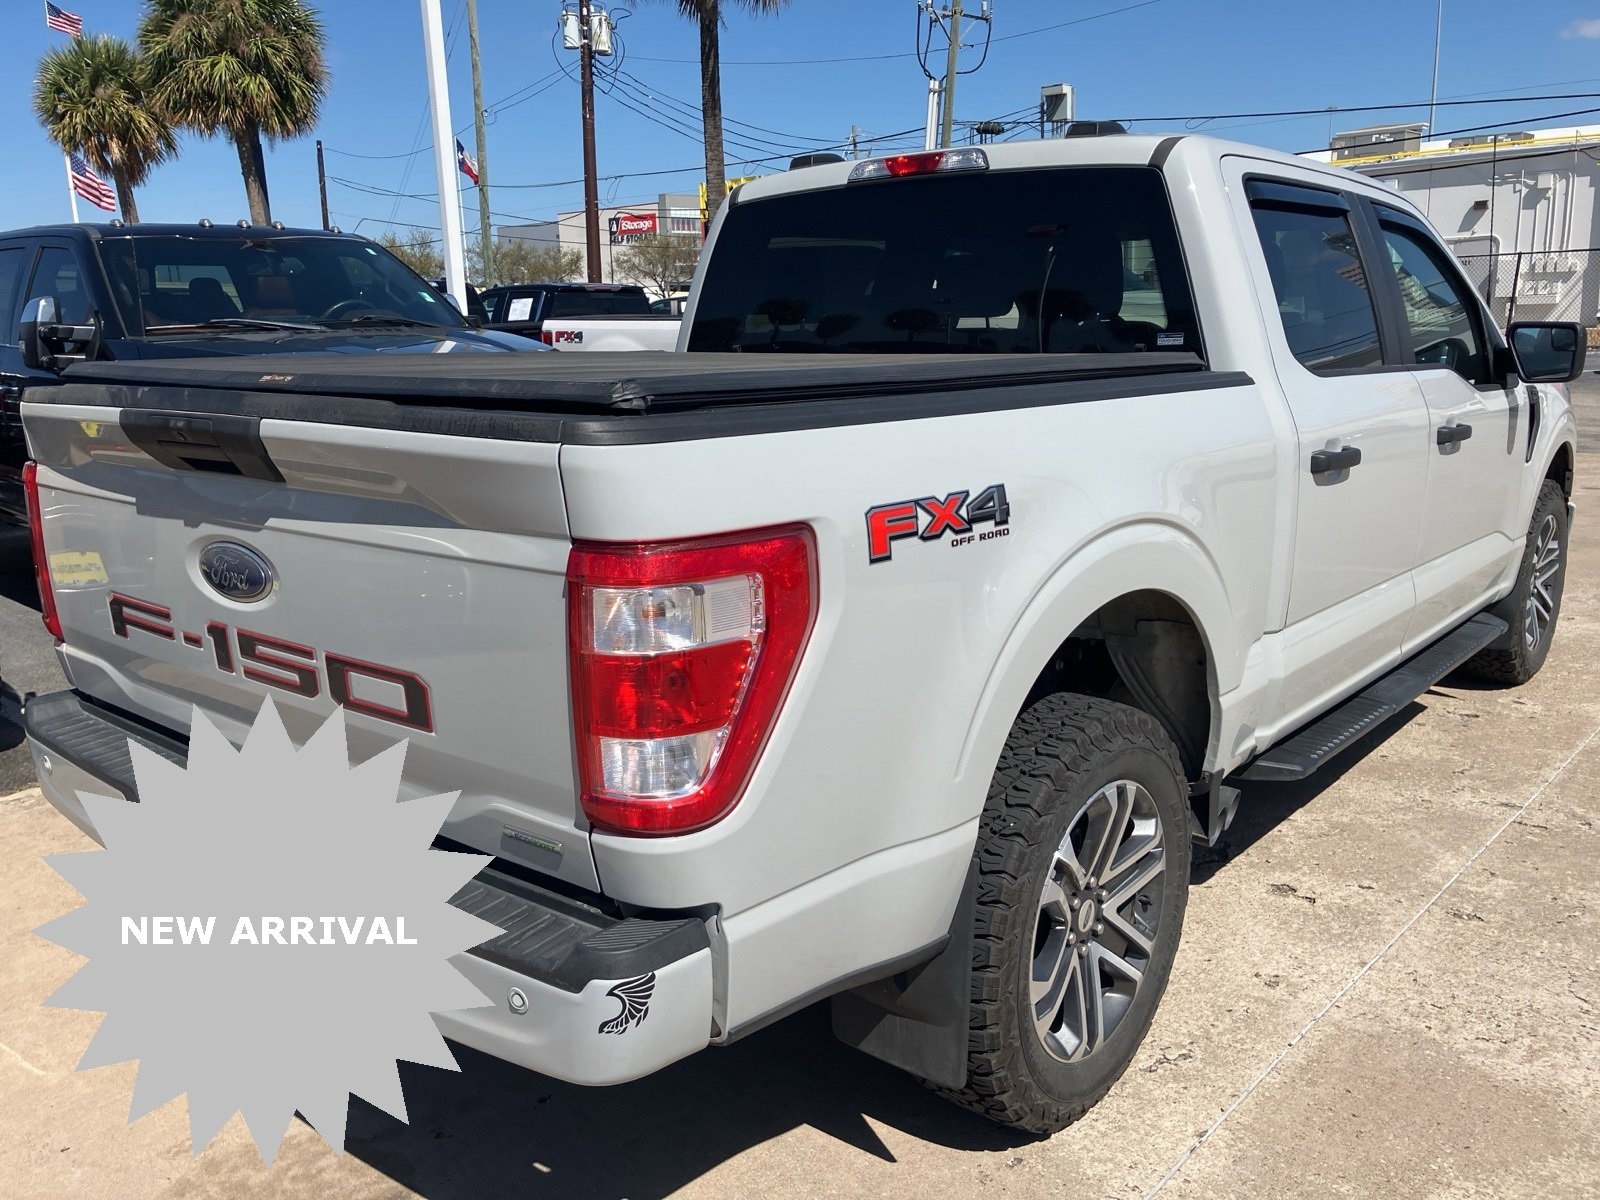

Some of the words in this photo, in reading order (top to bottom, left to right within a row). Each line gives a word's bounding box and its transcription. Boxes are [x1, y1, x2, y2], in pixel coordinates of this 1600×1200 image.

[621, 220, 653, 231] iStorage
[555, 330, 583, 343] FX4
[865, 483, 1010, 565] FX4
[951, 534, 975, 547] OFF
[979, 528, 1010, 542] ROAD
[210, 554, 249, 590] Ford
[108, 591, 435, 735] F-150
